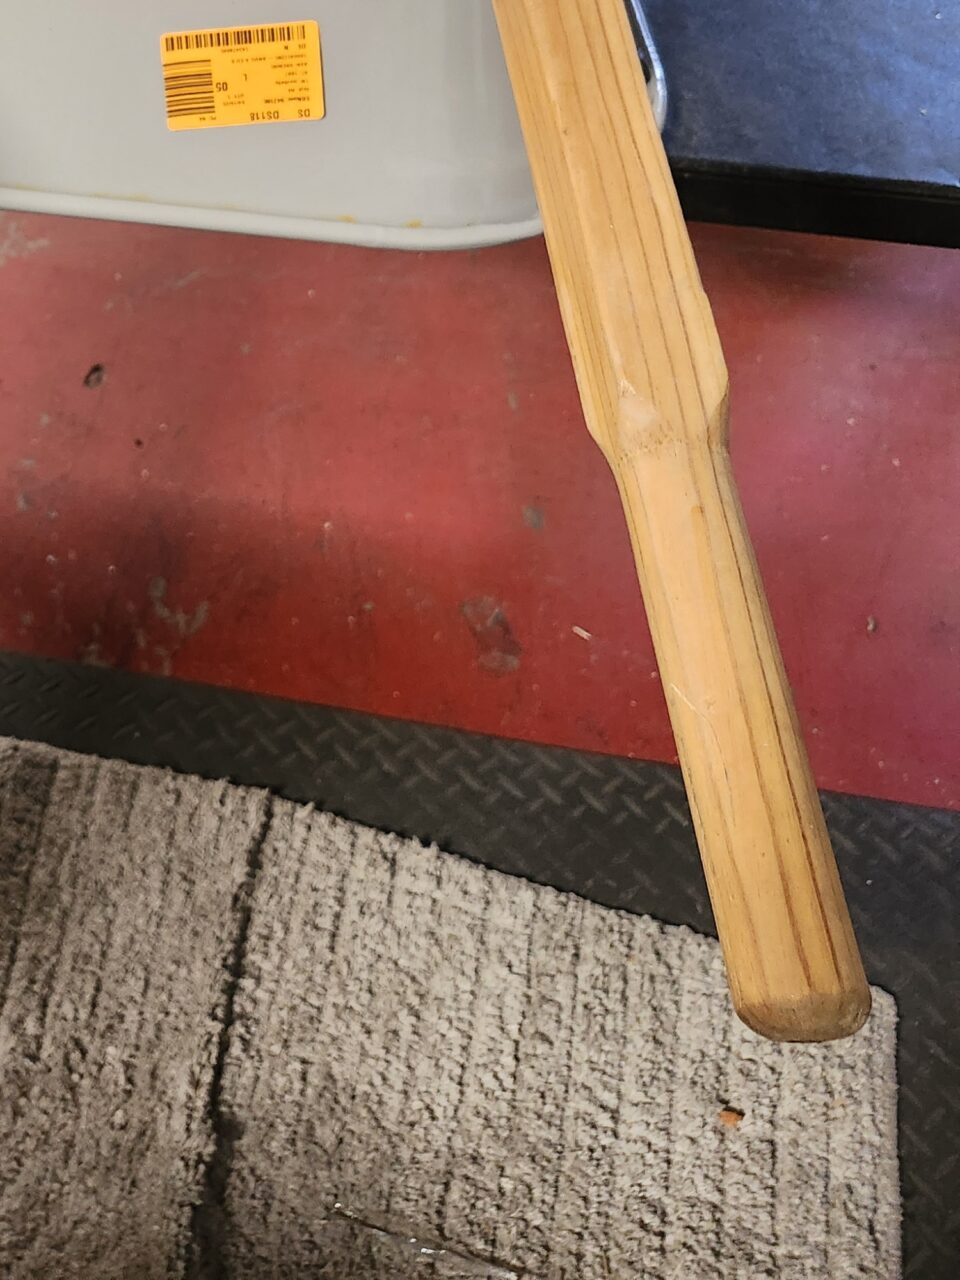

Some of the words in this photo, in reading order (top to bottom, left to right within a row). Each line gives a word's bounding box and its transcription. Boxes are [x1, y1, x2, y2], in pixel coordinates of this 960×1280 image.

[215, 81, 228, 92] 05
[250, 110, 279, 121] DS118
[298, 108, 311, 118] DS
